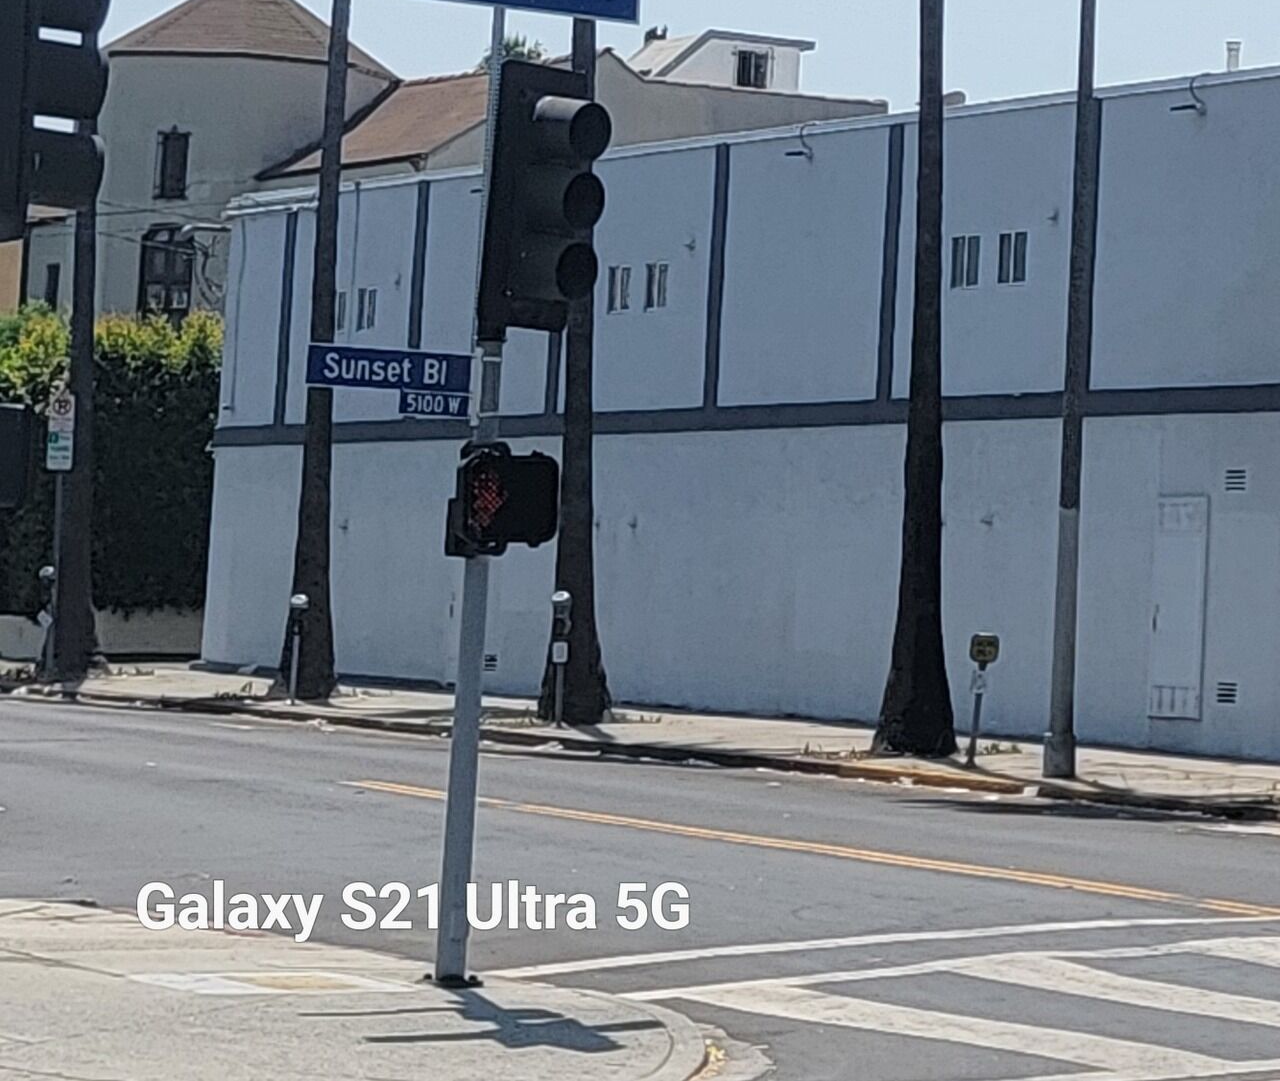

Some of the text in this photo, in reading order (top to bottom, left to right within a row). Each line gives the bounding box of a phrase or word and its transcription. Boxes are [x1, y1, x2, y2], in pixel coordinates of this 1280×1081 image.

[323, 352, 447, 386] Sunset Bl
[406, 394, 463, 415] 5100 W
